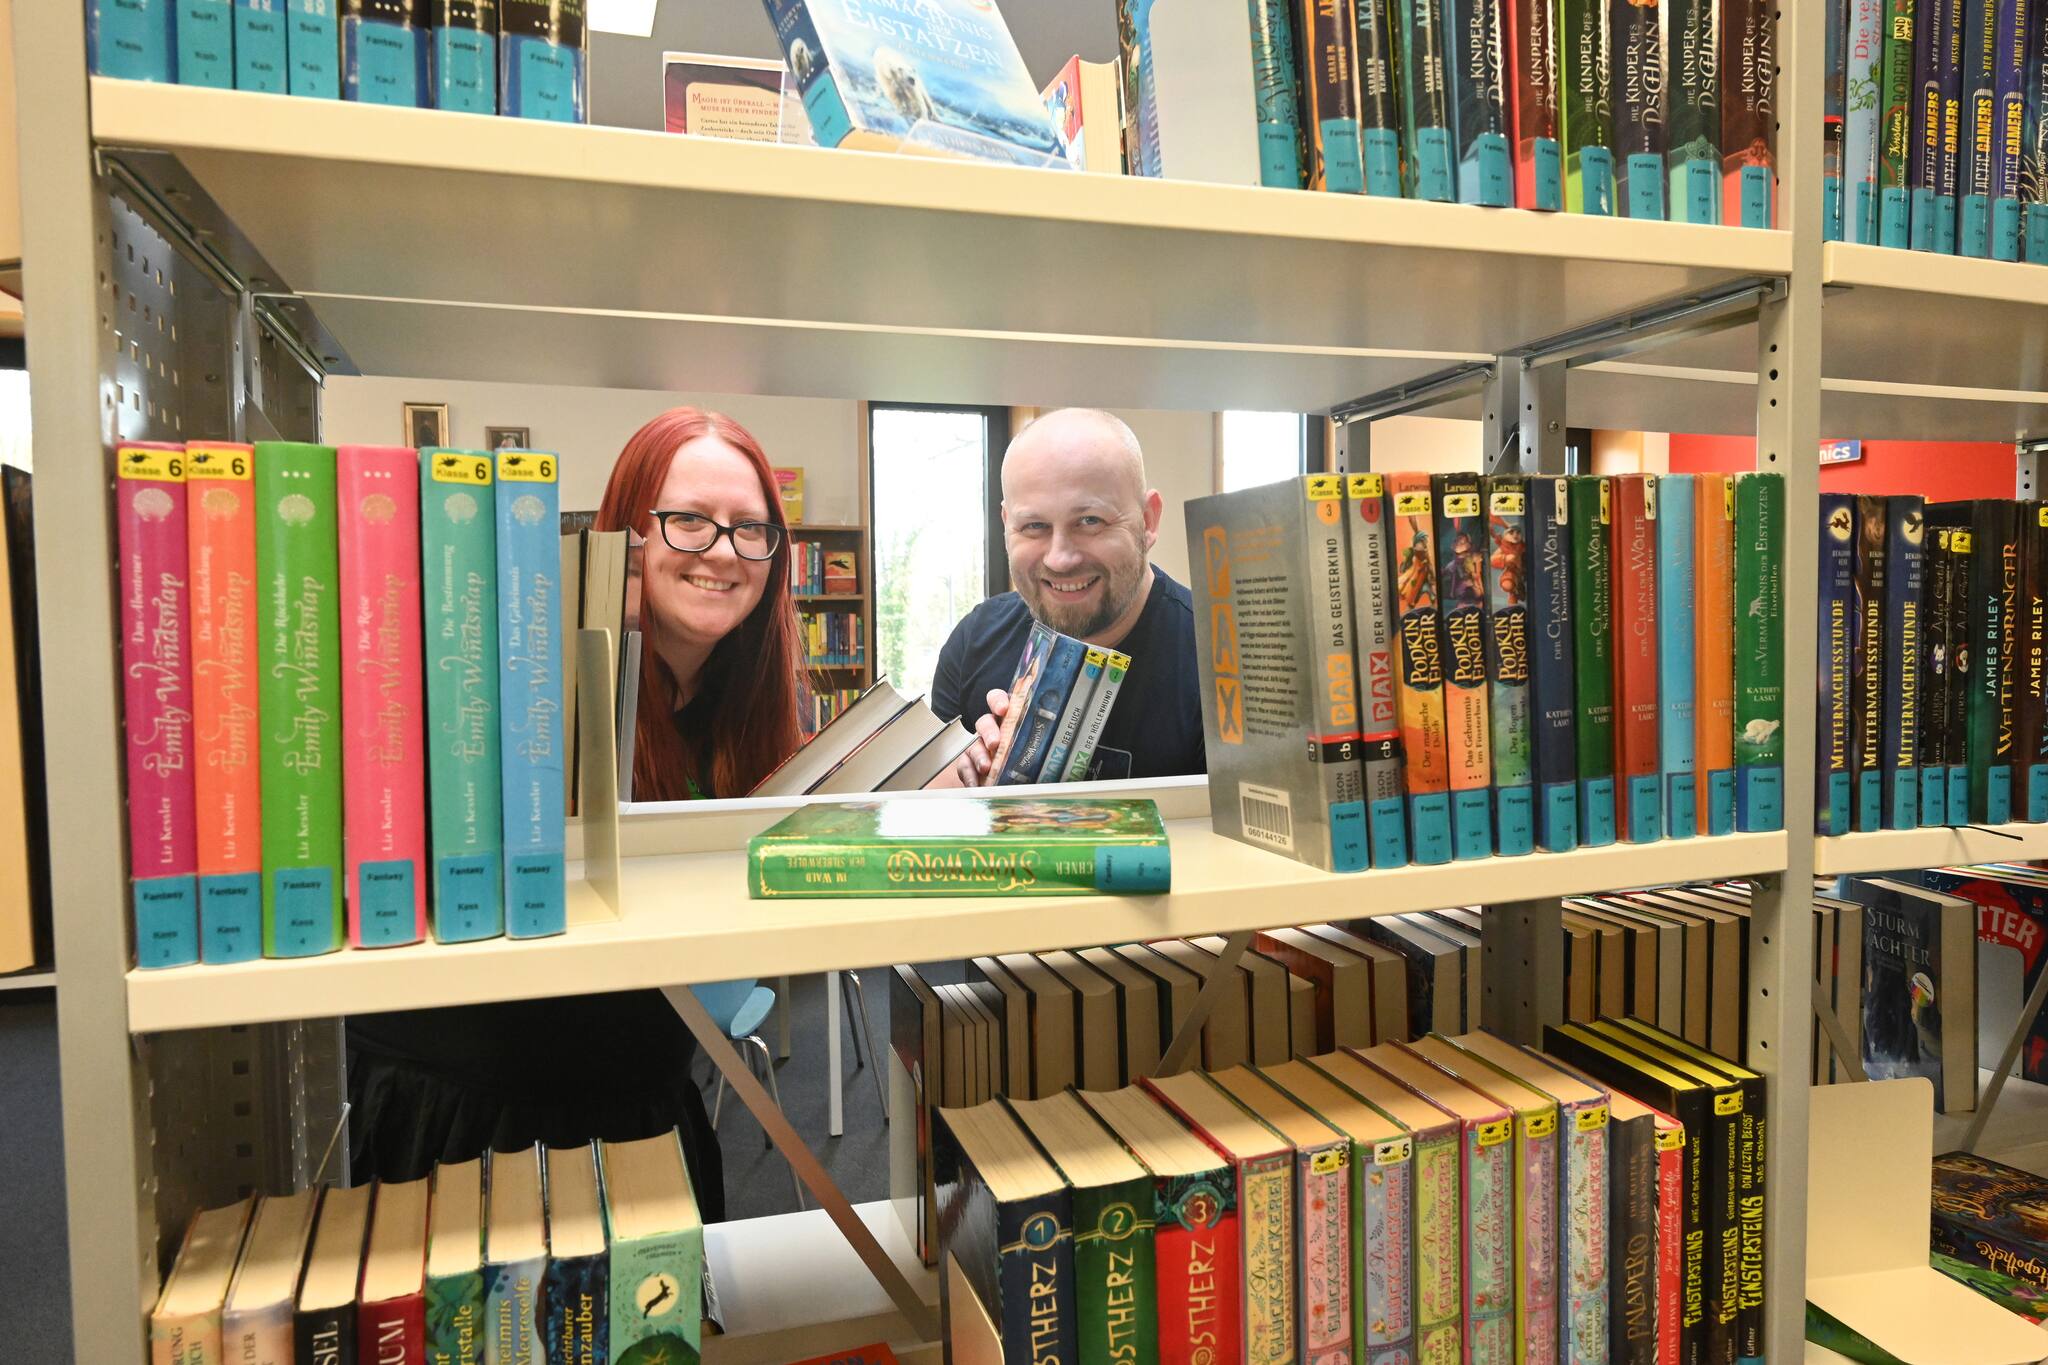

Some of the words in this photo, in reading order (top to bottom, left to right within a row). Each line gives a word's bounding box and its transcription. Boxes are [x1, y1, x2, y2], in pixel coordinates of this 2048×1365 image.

[1470, 17, 1485, 78] KINDER
[1854, 38, 1870, 59] Die
[1894, 17, 1906, 39] UND
[1530, 26, 1545, 86] KINDER
[1580, 32, 1595, 93] KINDER
[1626, 42, 1642, 103] KINDER
[1682, 28, 1699, 87] KINDER
[1742, 34, 1760, 93] KINDER
[1926, 91, 1940, 147] GAMERS
[1944, 99, 1959, 154] GAMERS
[1976, 98, 1994, 153] GAMERS
[2006, 102, 2024, 155] GAMERS
[169, 459, 183, 477] 6
[231, 458, 245, 476] 6
[475, 462, 487, 480] 6
[540, 460, 551, 477] 6
[1423, 497, 1430, 512] 5
[1471, 497, 1478, 512] 5
[1755, 485, 1769, 552] EISTATZEN
[131, 554, 143, 621] Abenteuer
[1326, 537, 1343, 619] GEISTERKIND
[1367, 532, 1383, 619] HEXENDÄMON
[440, 572, 487, 693] Windsnap
[443, 623, 455, 638] Die
[508, 573, 553, 693] Windsnap
[1333, 624, 1344, 647] DAS
[1374, 621, 1385, 645] DER
[1546, 594, 1561, 639] CLAN
[1589, 593, 1601, 637] CLAN
[1987, 595, 1998, 639] RILEY
[2032, 596, 2043, 640] RILEY
[130, 573, 184, 701] Windsnap
[272, 576, 325, 701] Windsnap
[275, 632, 288, 653] Die
[509, 631, 521, 648] Das
[1405, 617, 1430, 683] PODKIN
[1420, 612, 1441, 683] EINOHR
[1450, 616, 1474, 681] PODKIN
[1464, 611, 1485, 681] EINOHR
[1493, 616, 1517, 681] PODKIN
[1510, 611, 1529, 681] EINOHR
[1997, 542, 2018, 757] WELTENSPRINGER
[1327, 654, 1356, 726] PAX
[1369, 652, 1395, 722] PAX
[1746, 686, 1781, 695] KATHRYN
[1831, 599, 1844, 768] MITTERNACHTSSTUNDE
[1863, 599, 1879, 767] MITTERNACHTSSTUNDE
[1898, 601, 1916, 767] MITTERNACHTSSTUNDE
[1986, 646, 1997, 697] JAMES
[2030, 646, 2042, 697] JAMES
[1067, 706, 1082, 730] FLUCH
[1084, 735, 1095, 750] DER
[1092, 689, 1114, 735] HÖLLENHUND
[1465, 696, 1474, 743] Geheimnis
[1753, 694, 1777, 702] LASKY
[133, 706, 192, 778] Emily
[275, 705, 329, 777] Emily
[442, 695, 493, 764] Emily
[511, 695, 558, 764] Emily
[1061, 730, 1074, 745] DER
[1422, 702, 1434, 743] magische
[1509, 704, 1520, 738] Bogen
[1423, 745, 1433, 768] Der
[1465, 744, 1475, 768] Das
[1508, 739, 1518, 755] Der
[158, 797, 174, 842] Kessler
[223, 794, 236, 837] Kessler
[297, 794, 310, 837] Kessler
[380, 787, 393, 830] Kessler
[463, 781, 475, 824] Kessler
[530, 781, 541, 824] Kessler
[161, 846, 174, 863] Liz
[223, 844, 236, 859] Liz
[297, 844, 310, 859] Liz
[381, 835, 393, 851] Liz
[465, 829, 476, 843] Liz
[530, 829, 542, 843] Liz
[209, 886, 249, 896] Fantasy
[284, 881, 322, 890] Fantasy
[367, 873, 404, 881] Fantasy
[450, 866, 485, 876] Fantasy
[516, 865, 551, 874] Fantasy
[806, 873, 830, 885] WALD
[831, 873, 848, 884] IM
[143, 890, 184, 901] Fantasy
[1866, 906, 1920, 940] STURM
[1503, 1123, 1510, 1137] 5
[1550, 1117, 1556, 1130] 5
[1600, 1110, 1607, 1124] 5
[1741, 1112, 1753, 1139] BEISST
[1338, 1153, 1346, 1167] 5
[1402, 1143, 1410, 1157] 5
[1742, 1141, 1753, 1173] LETZTEN
[1742, 1173, 1752, 1189] DEN
[1034, 1220, 1046, 1241] 1
[1111, 1210, 1125, 1233] 2
[1193, 1200, 1208, 1223] 3
[1439, 1153, 1453, 1311] GLÜCKSBÄCKEREI
[1250, 1253, 1268, 1293] Die
[1267, 1174, 1285, 1357] GLÜCKSBÄCKEREI
[1311, 1253, 1325, 1273] Die
[1738, 1195, 1764, 1310] FINSTERSTEINS
[1624, 1233, 1649, 1340] PALADERO
[1683, 1229, 1703, 1328] FINSTERSTEINS
[1719, 1226, 1740, 1325] FINSTERSTEINS
[243, 1332, 257, 1360] DER
[1747, 1327, 1756, 1357] Lüftner
